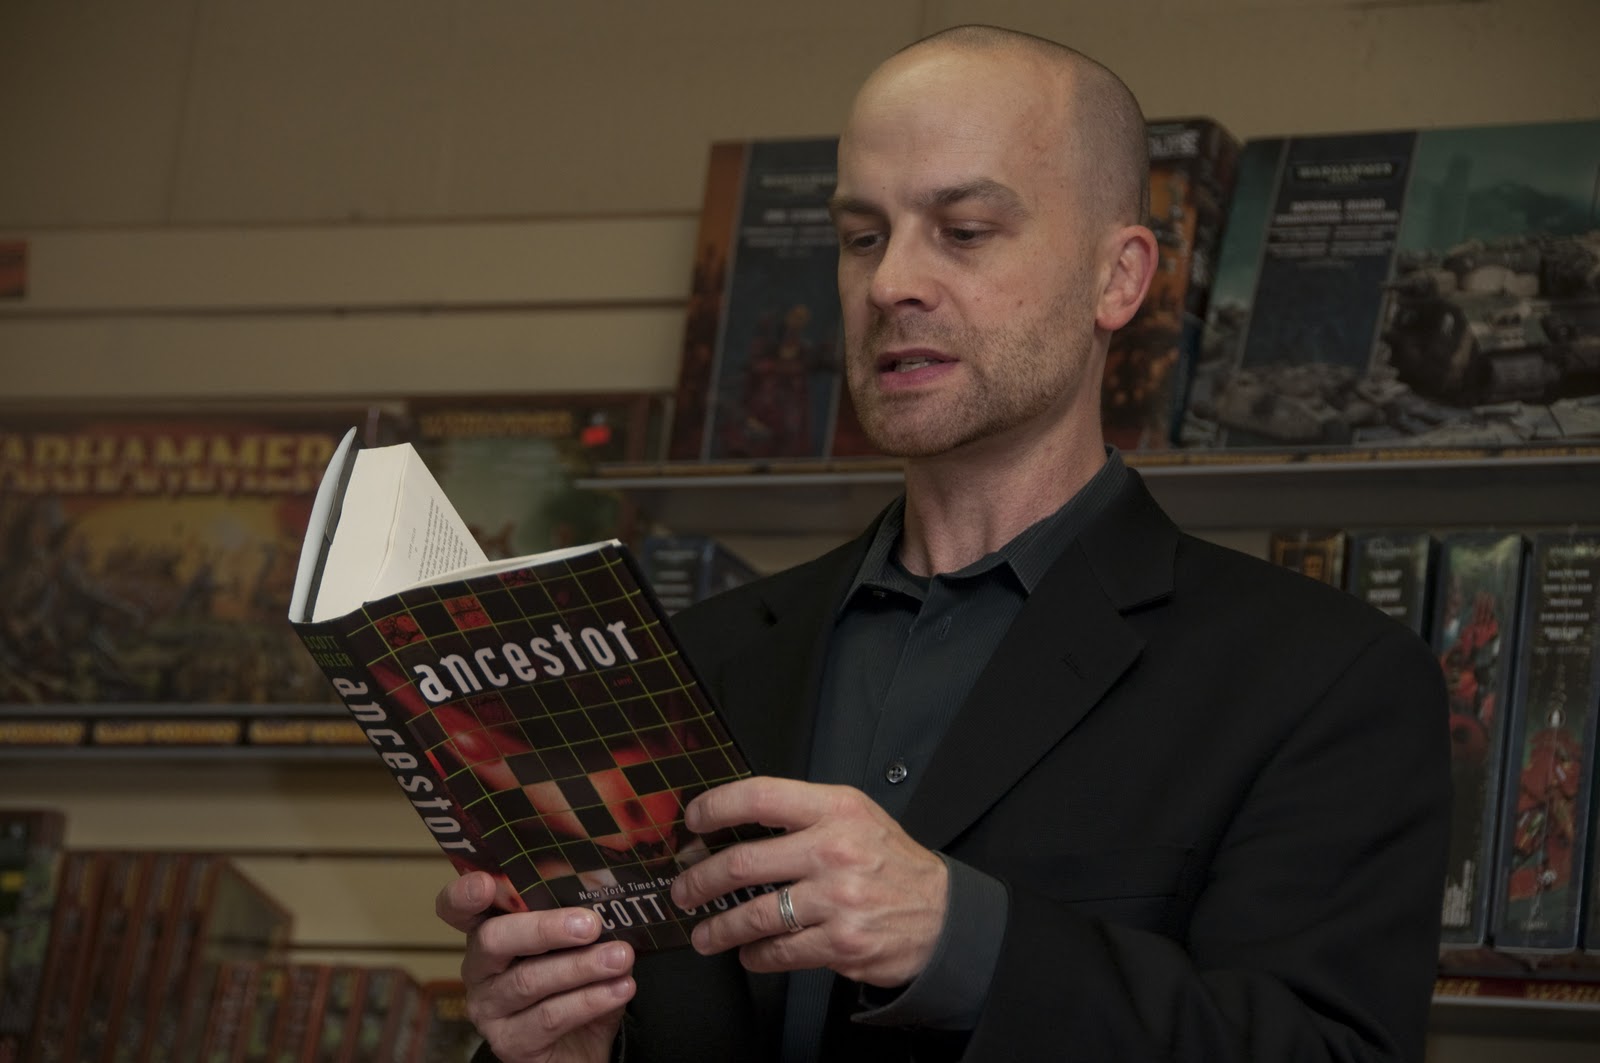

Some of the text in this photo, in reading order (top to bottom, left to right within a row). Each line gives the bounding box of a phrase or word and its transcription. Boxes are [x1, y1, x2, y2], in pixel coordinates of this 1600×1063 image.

[413, 620, 639, 703] ancestor
[332, 677, 477, 853] ancestor
[578, 890, 601, 901] New
[603, 884, 626, 897] York
[627, 880, 657, 892] Times
[592, 893, 667, 930] COTT
